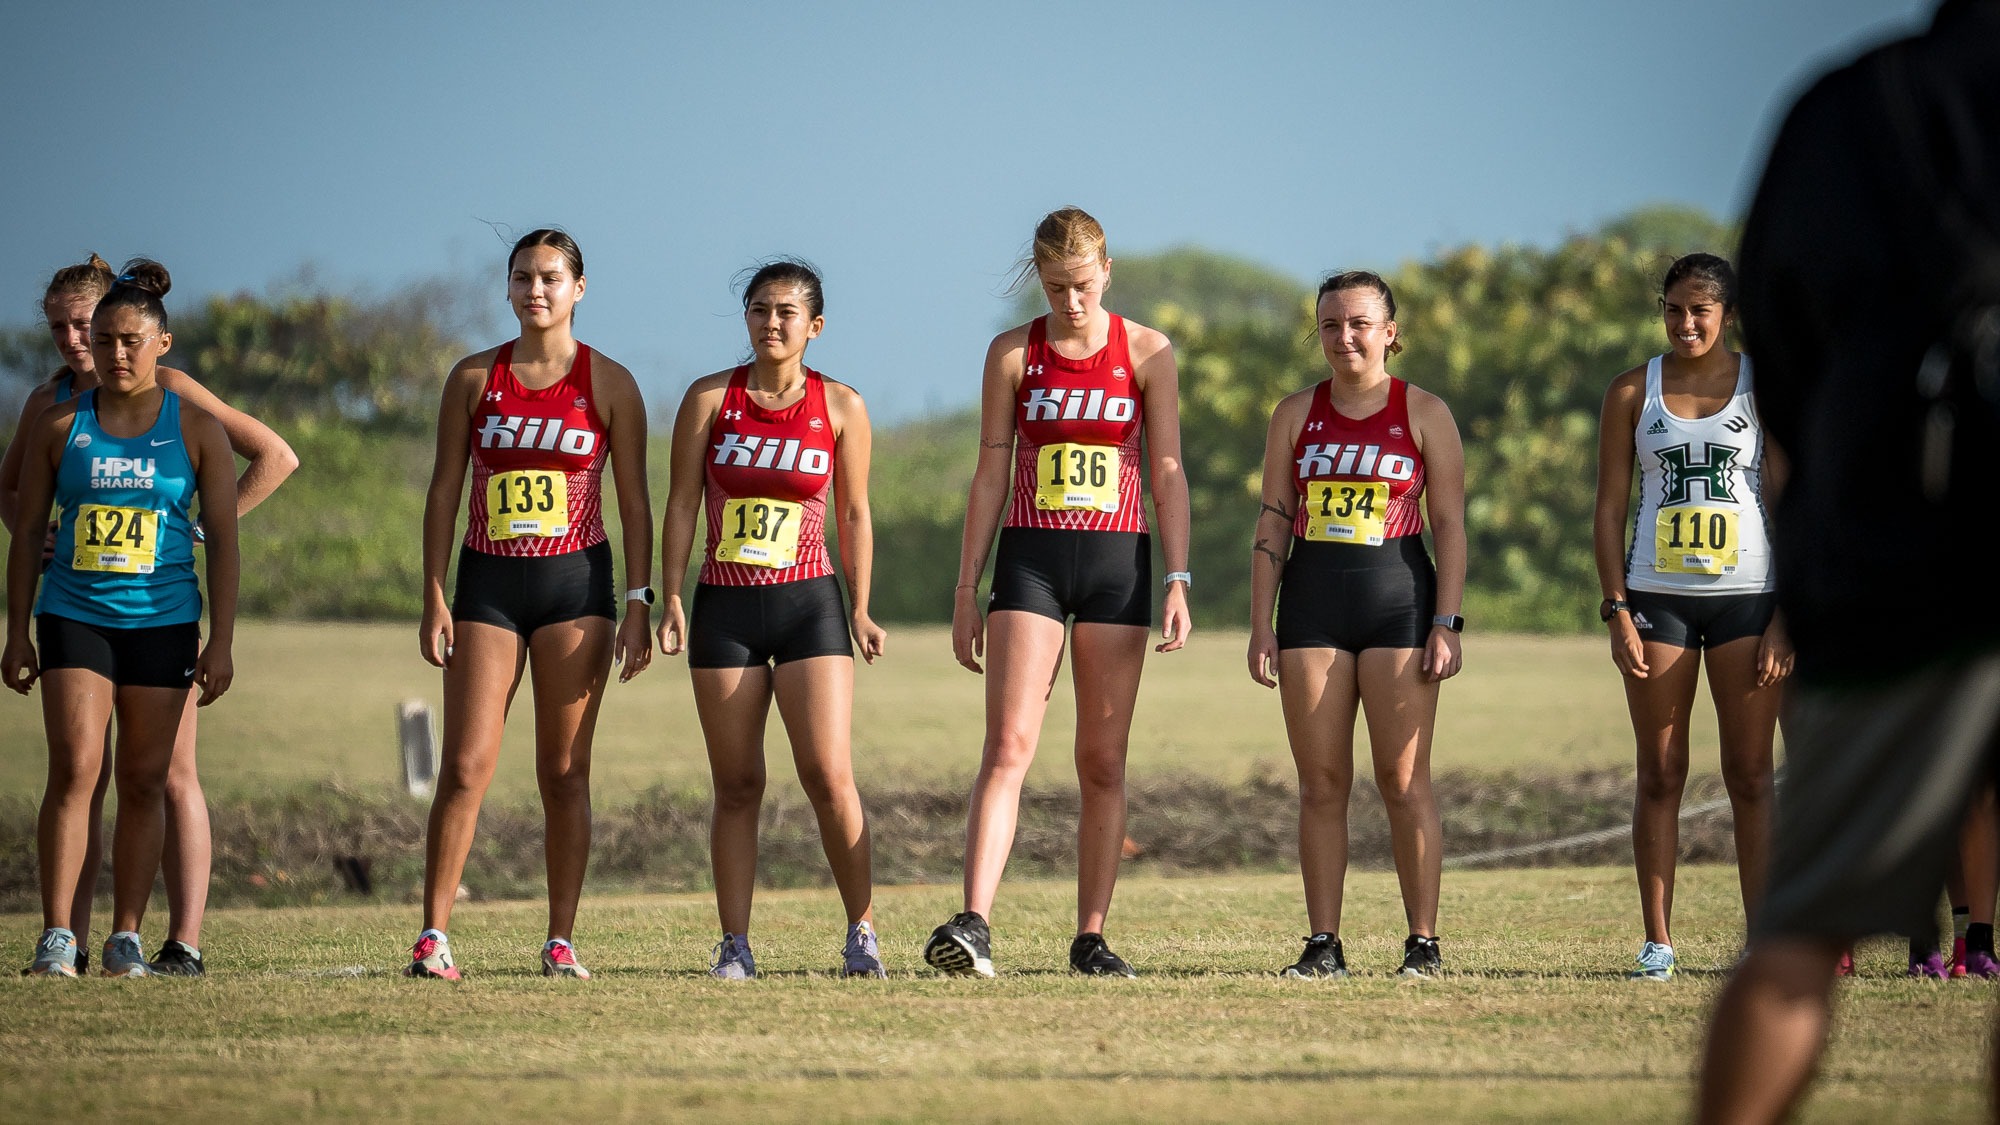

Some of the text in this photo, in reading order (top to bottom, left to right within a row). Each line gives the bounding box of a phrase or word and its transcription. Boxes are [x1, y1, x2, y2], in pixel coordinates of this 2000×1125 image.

[91, 457, 155, 477] HPU
[91, 477, 154, 489] SHARKS
[1051, 449, 1107, 487] 136
[1653, 442, 1741, 509] H
[497, 475, 554, 515] 133
[1320, 487, 1375, 520] 134
[85, 510, 144, 548] 124
[733, 504, 789, 542] 137
[1668, 512, 1727, 549] 110
